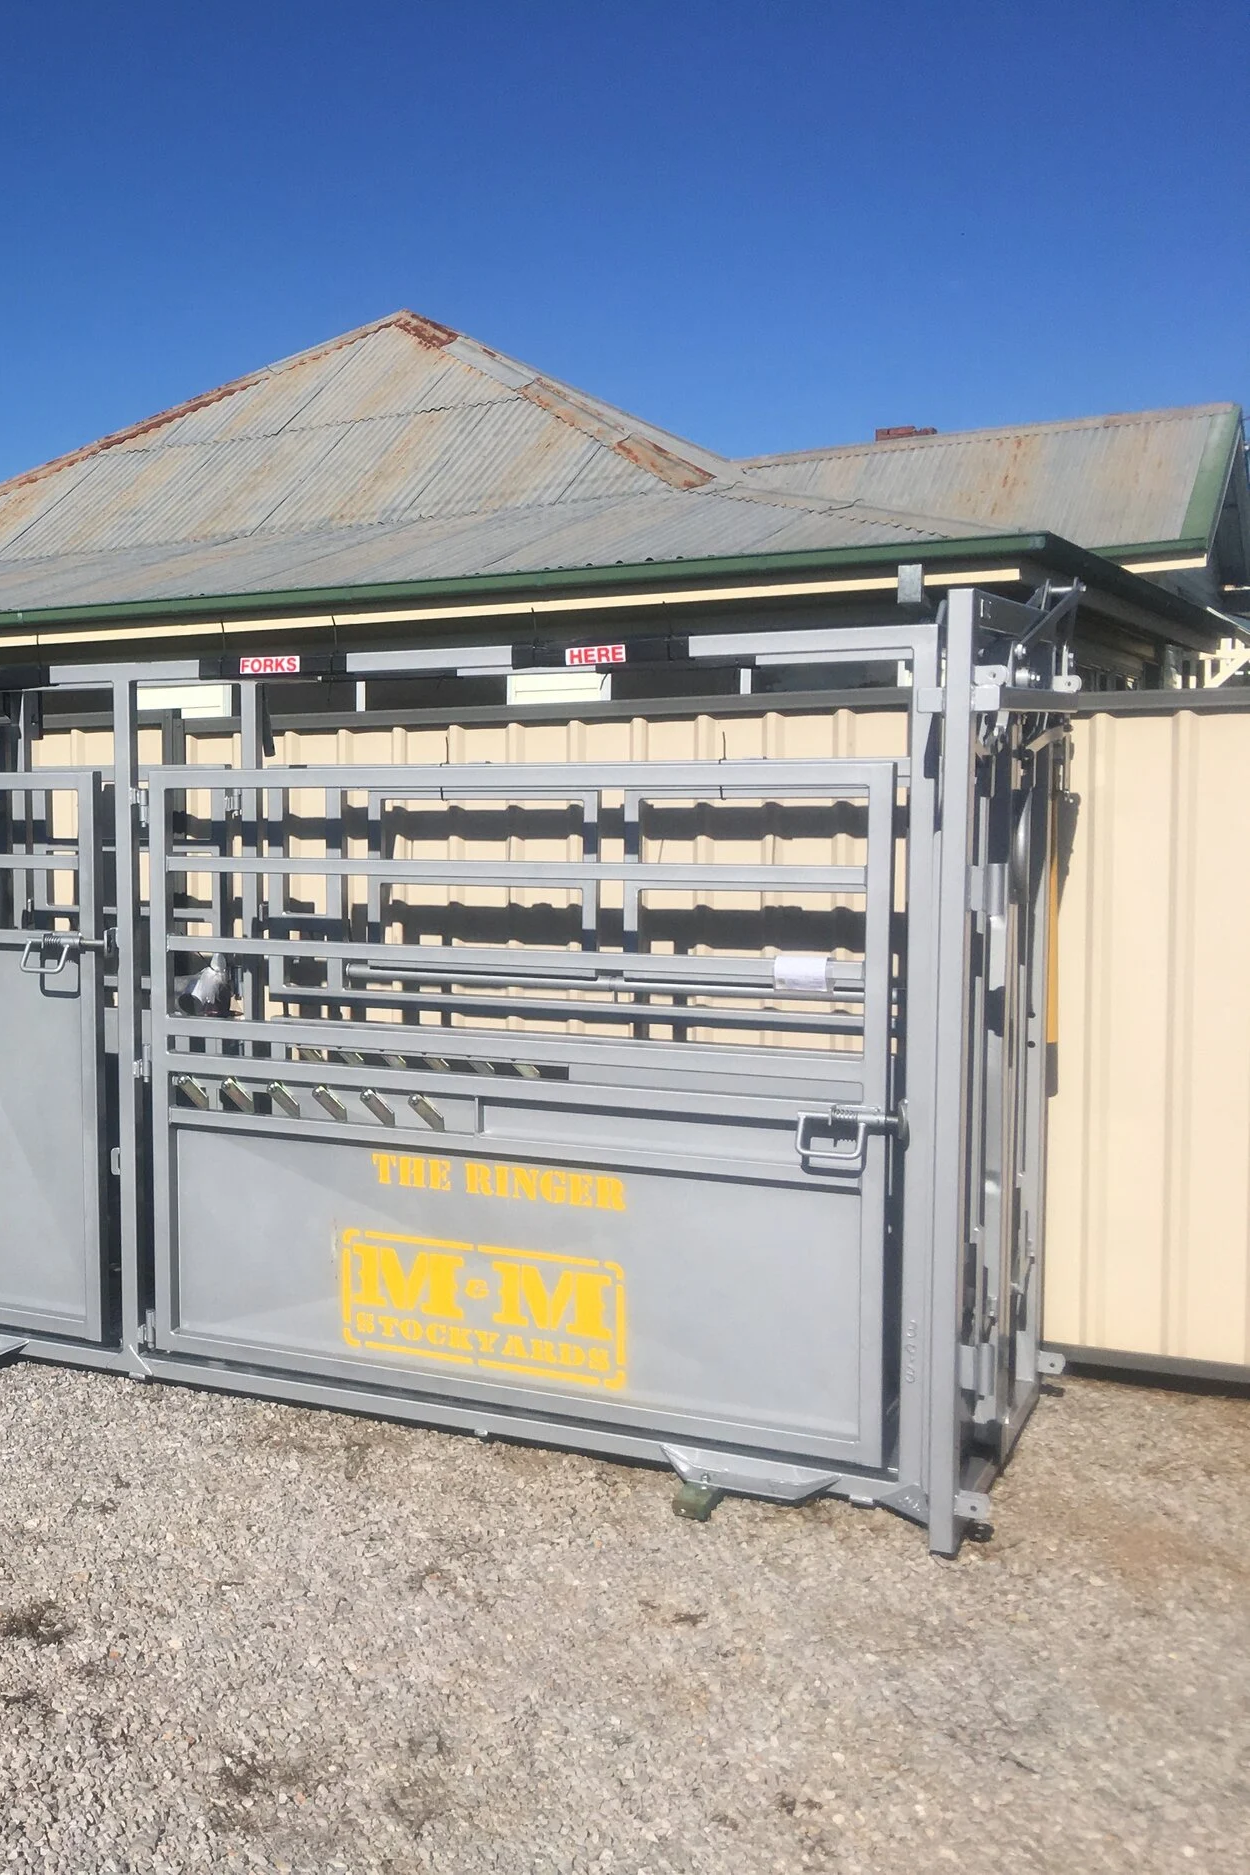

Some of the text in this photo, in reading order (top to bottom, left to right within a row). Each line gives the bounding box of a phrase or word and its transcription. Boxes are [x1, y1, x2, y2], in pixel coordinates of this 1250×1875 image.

[241, 657, 297, 673] FORKS
[570, 646, 624, 664] HERE
[372, 1153, 626, 1211] THE RINGER
[356, 1312, 610, 1372] STOCKYARDS
